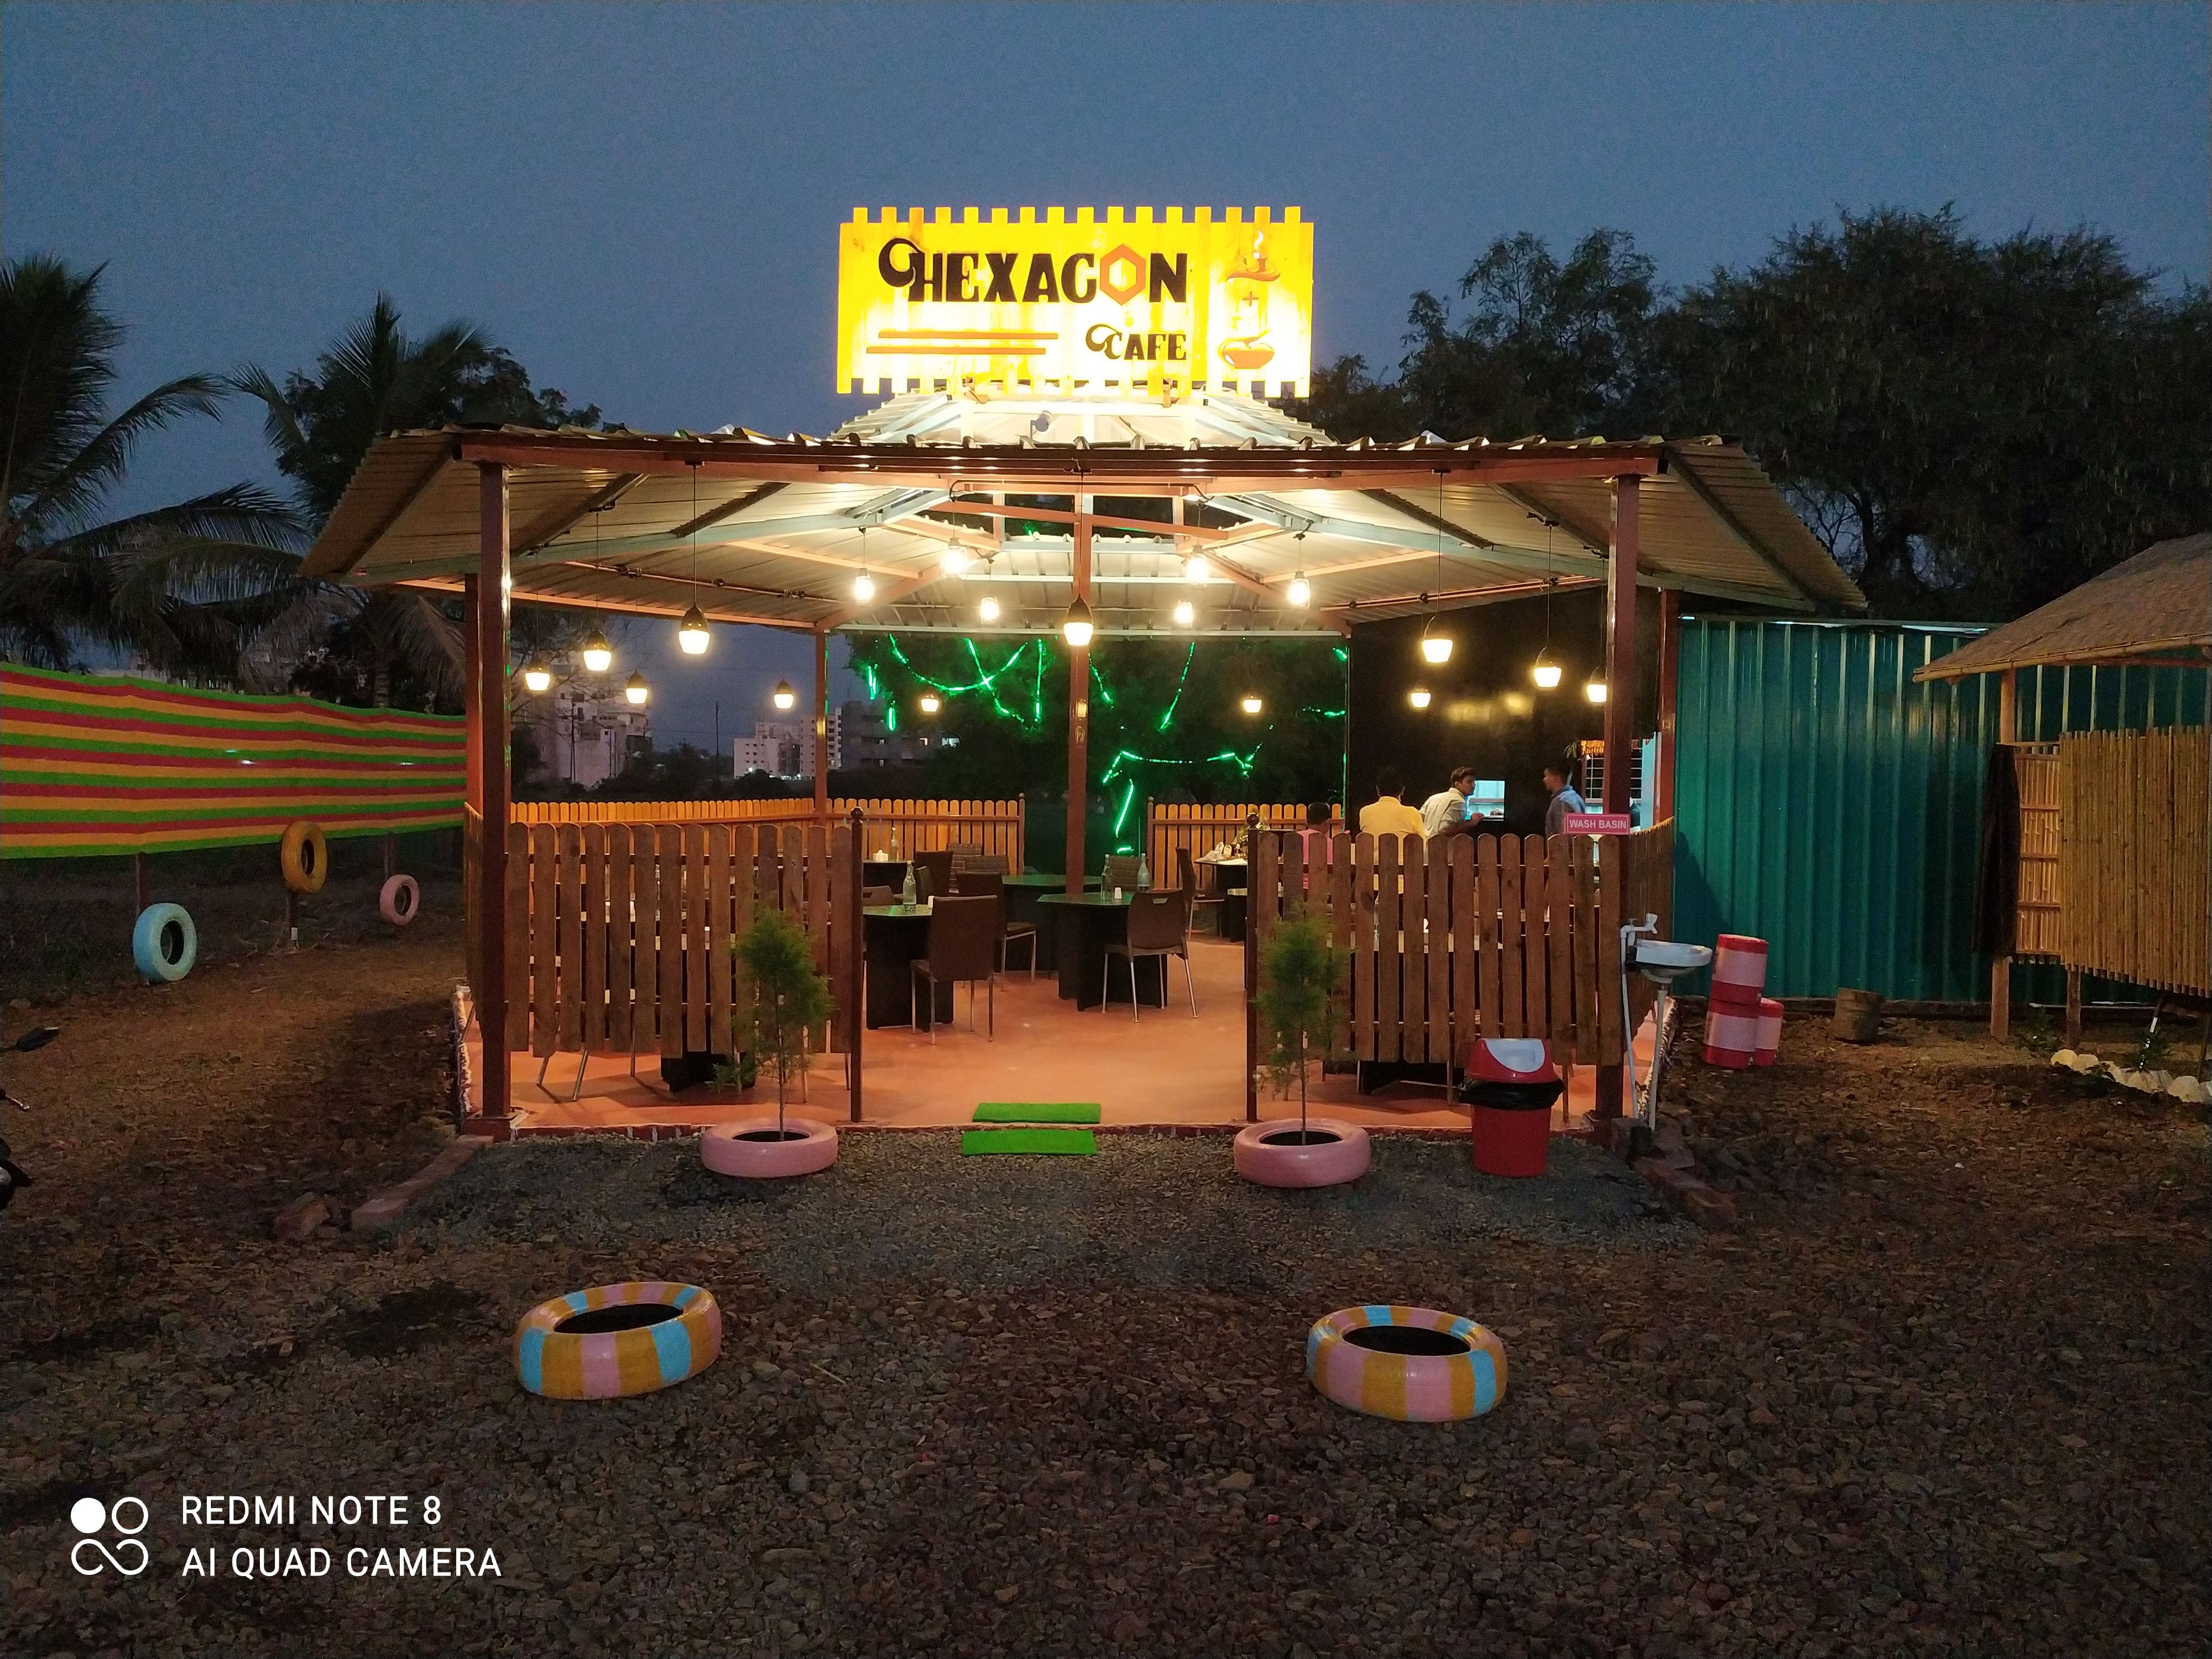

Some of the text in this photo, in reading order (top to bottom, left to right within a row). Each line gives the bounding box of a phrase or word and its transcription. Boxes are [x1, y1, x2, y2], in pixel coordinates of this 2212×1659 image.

[878, 238, 1187, 305] HEXAGON
[1085, 324, 1187, 361] CAFE
[1569, 820, 1626, 829] WASH BASIN
